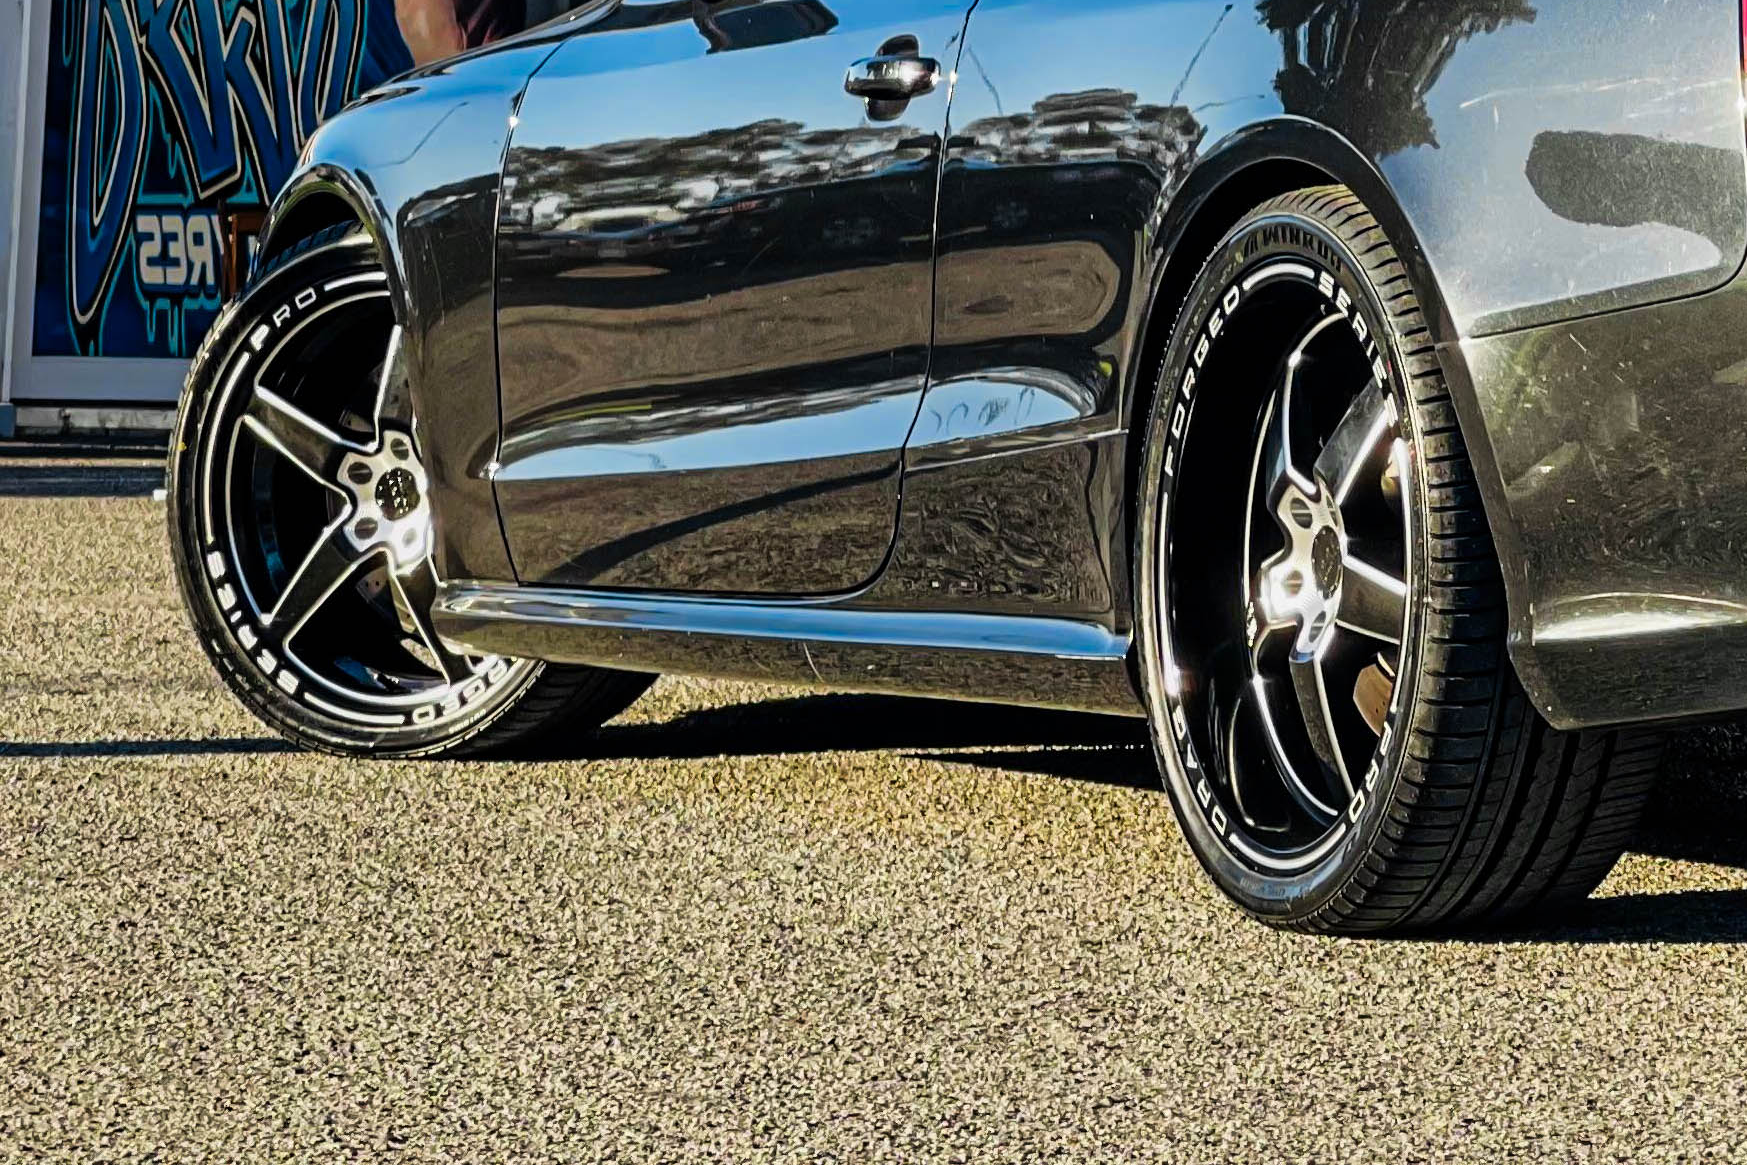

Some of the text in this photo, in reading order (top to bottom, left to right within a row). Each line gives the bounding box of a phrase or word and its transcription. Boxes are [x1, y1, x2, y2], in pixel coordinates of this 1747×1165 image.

[250, 287, 316, 351] PRO
[1164, 285, 1240, 476] FORGED
[1319, 271, 1398, 427] SERIES
[1173, 705, 1227, 836] DRAG
[1349, 721, 1392, 823] PRO
